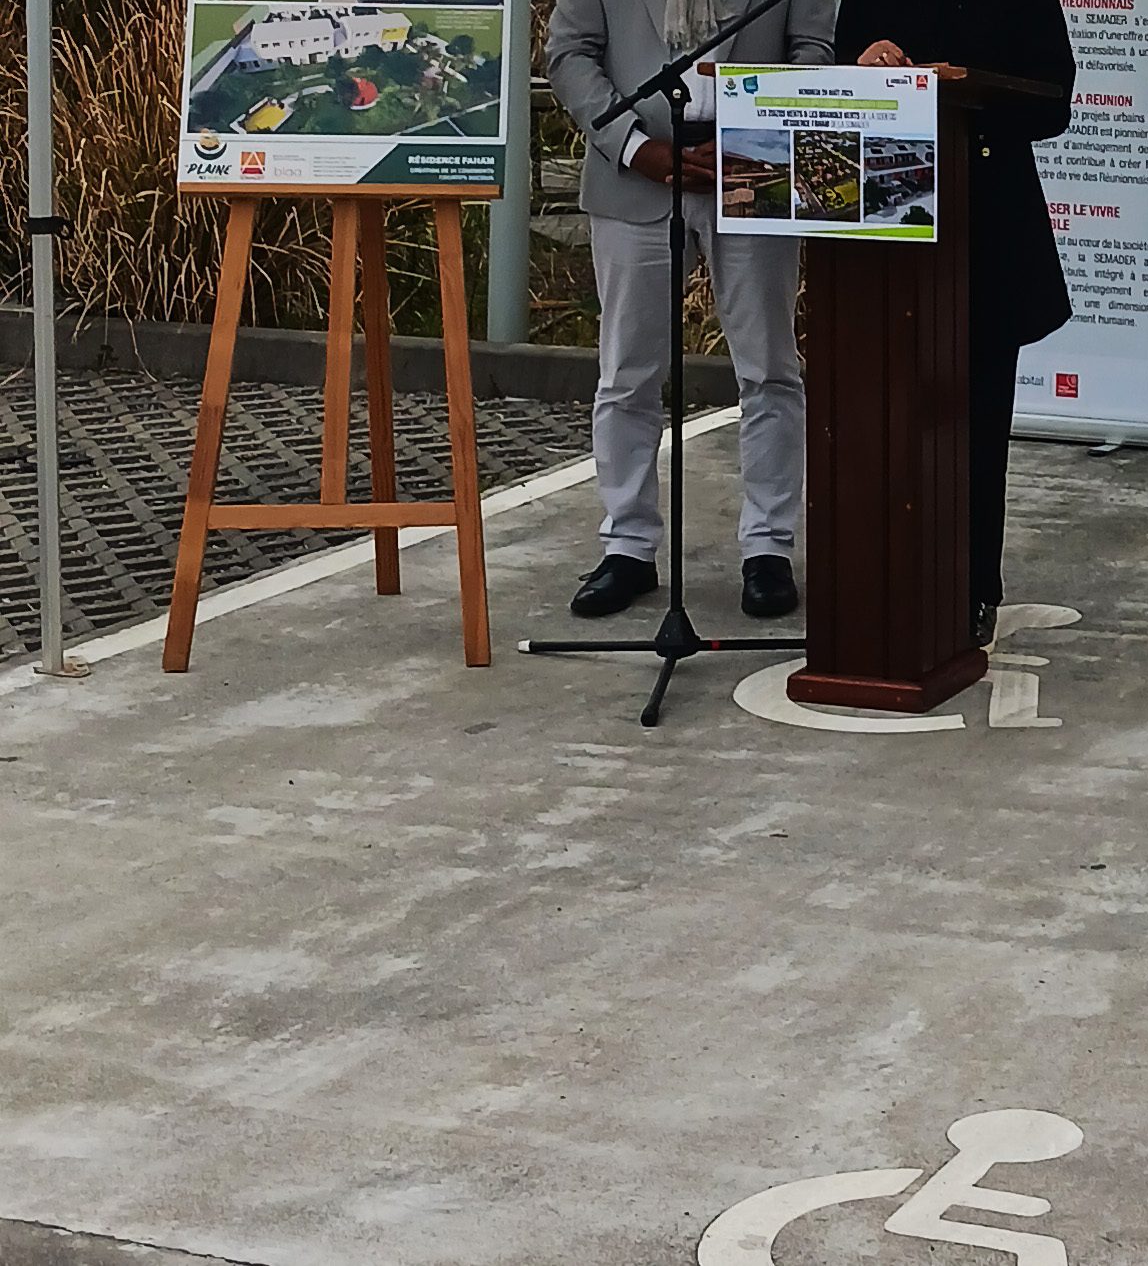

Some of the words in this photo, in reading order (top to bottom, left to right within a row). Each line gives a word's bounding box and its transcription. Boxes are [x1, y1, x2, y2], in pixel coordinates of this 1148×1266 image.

[1086, 14, 1127, 25] SEMADER
[1086, 94, 1133, 107] REUNION
[1081, 111, 1110, 123] projets
[1074, 204, 1088, 216] LE
[1089, 205, 1120, 218] VIVRE
[1094, 253, 1136, 265] SEMADER
